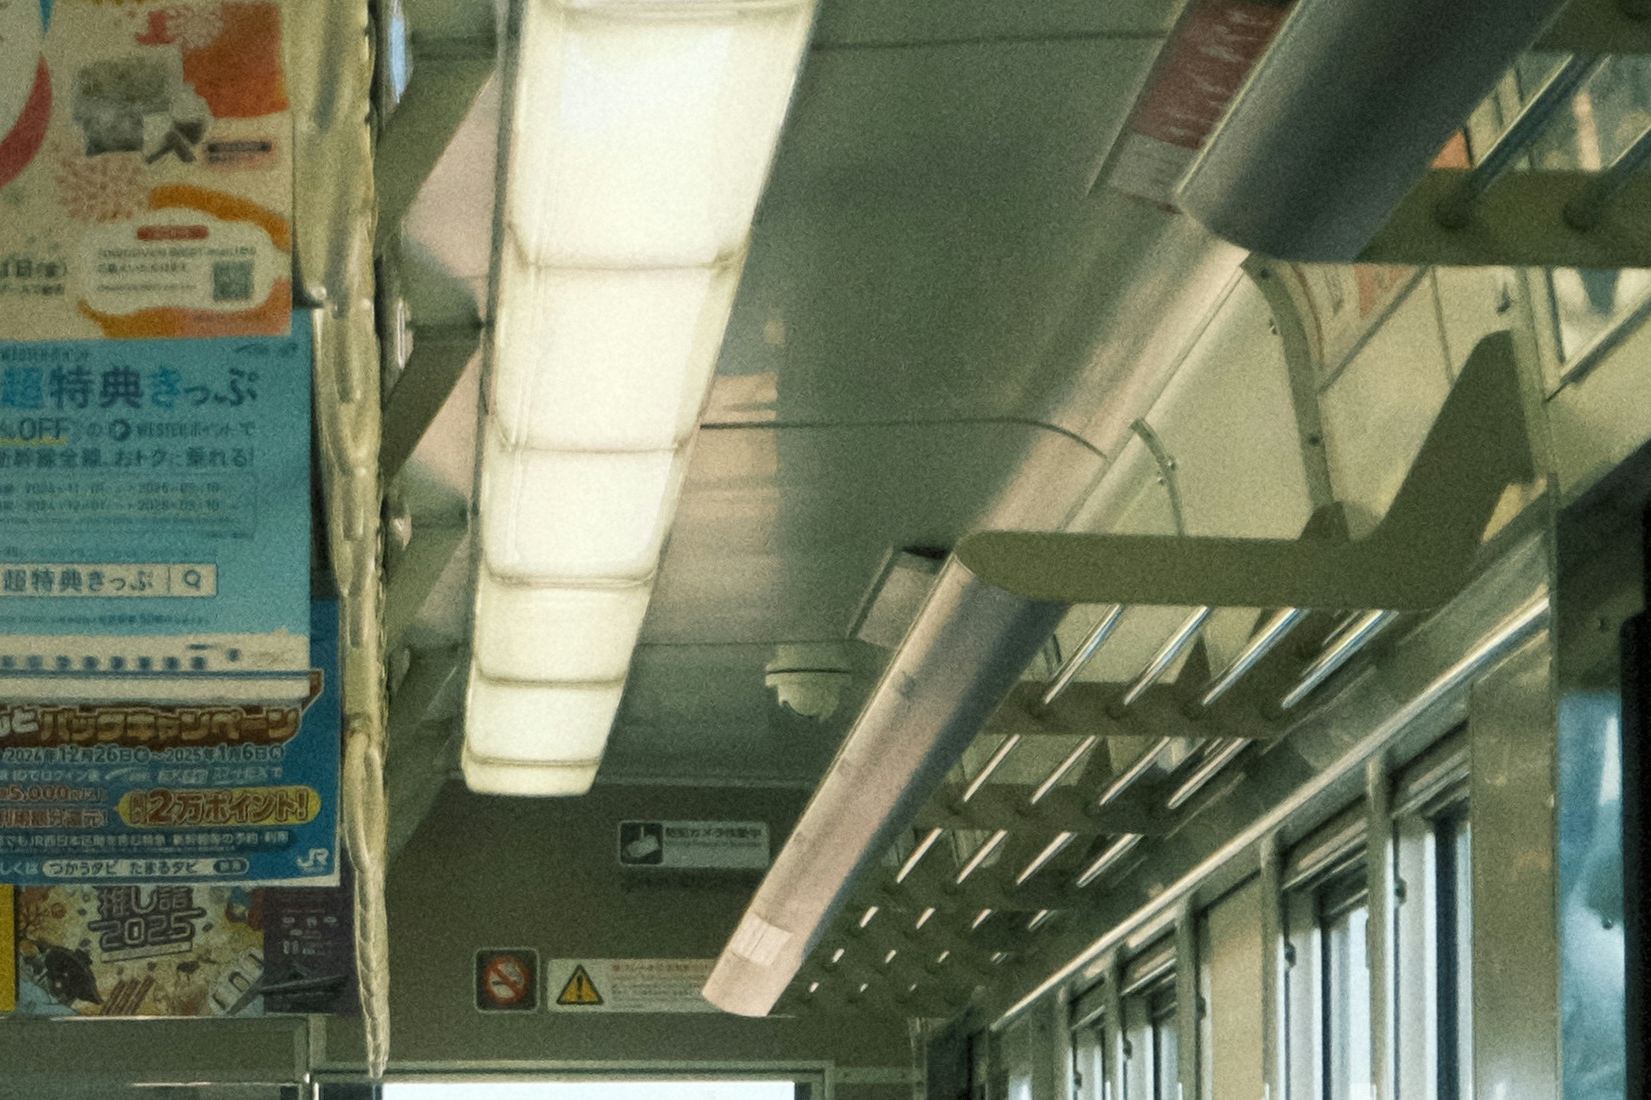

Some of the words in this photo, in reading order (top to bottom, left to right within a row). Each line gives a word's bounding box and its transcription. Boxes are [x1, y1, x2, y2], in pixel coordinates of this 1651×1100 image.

[0, 365, 259, 409] 超特典きっぷ
[2, 568, 154, 594] 超特典きっぷ
[296, 848, 331, 869] JR
[89, 907, 206, 950] 2025
